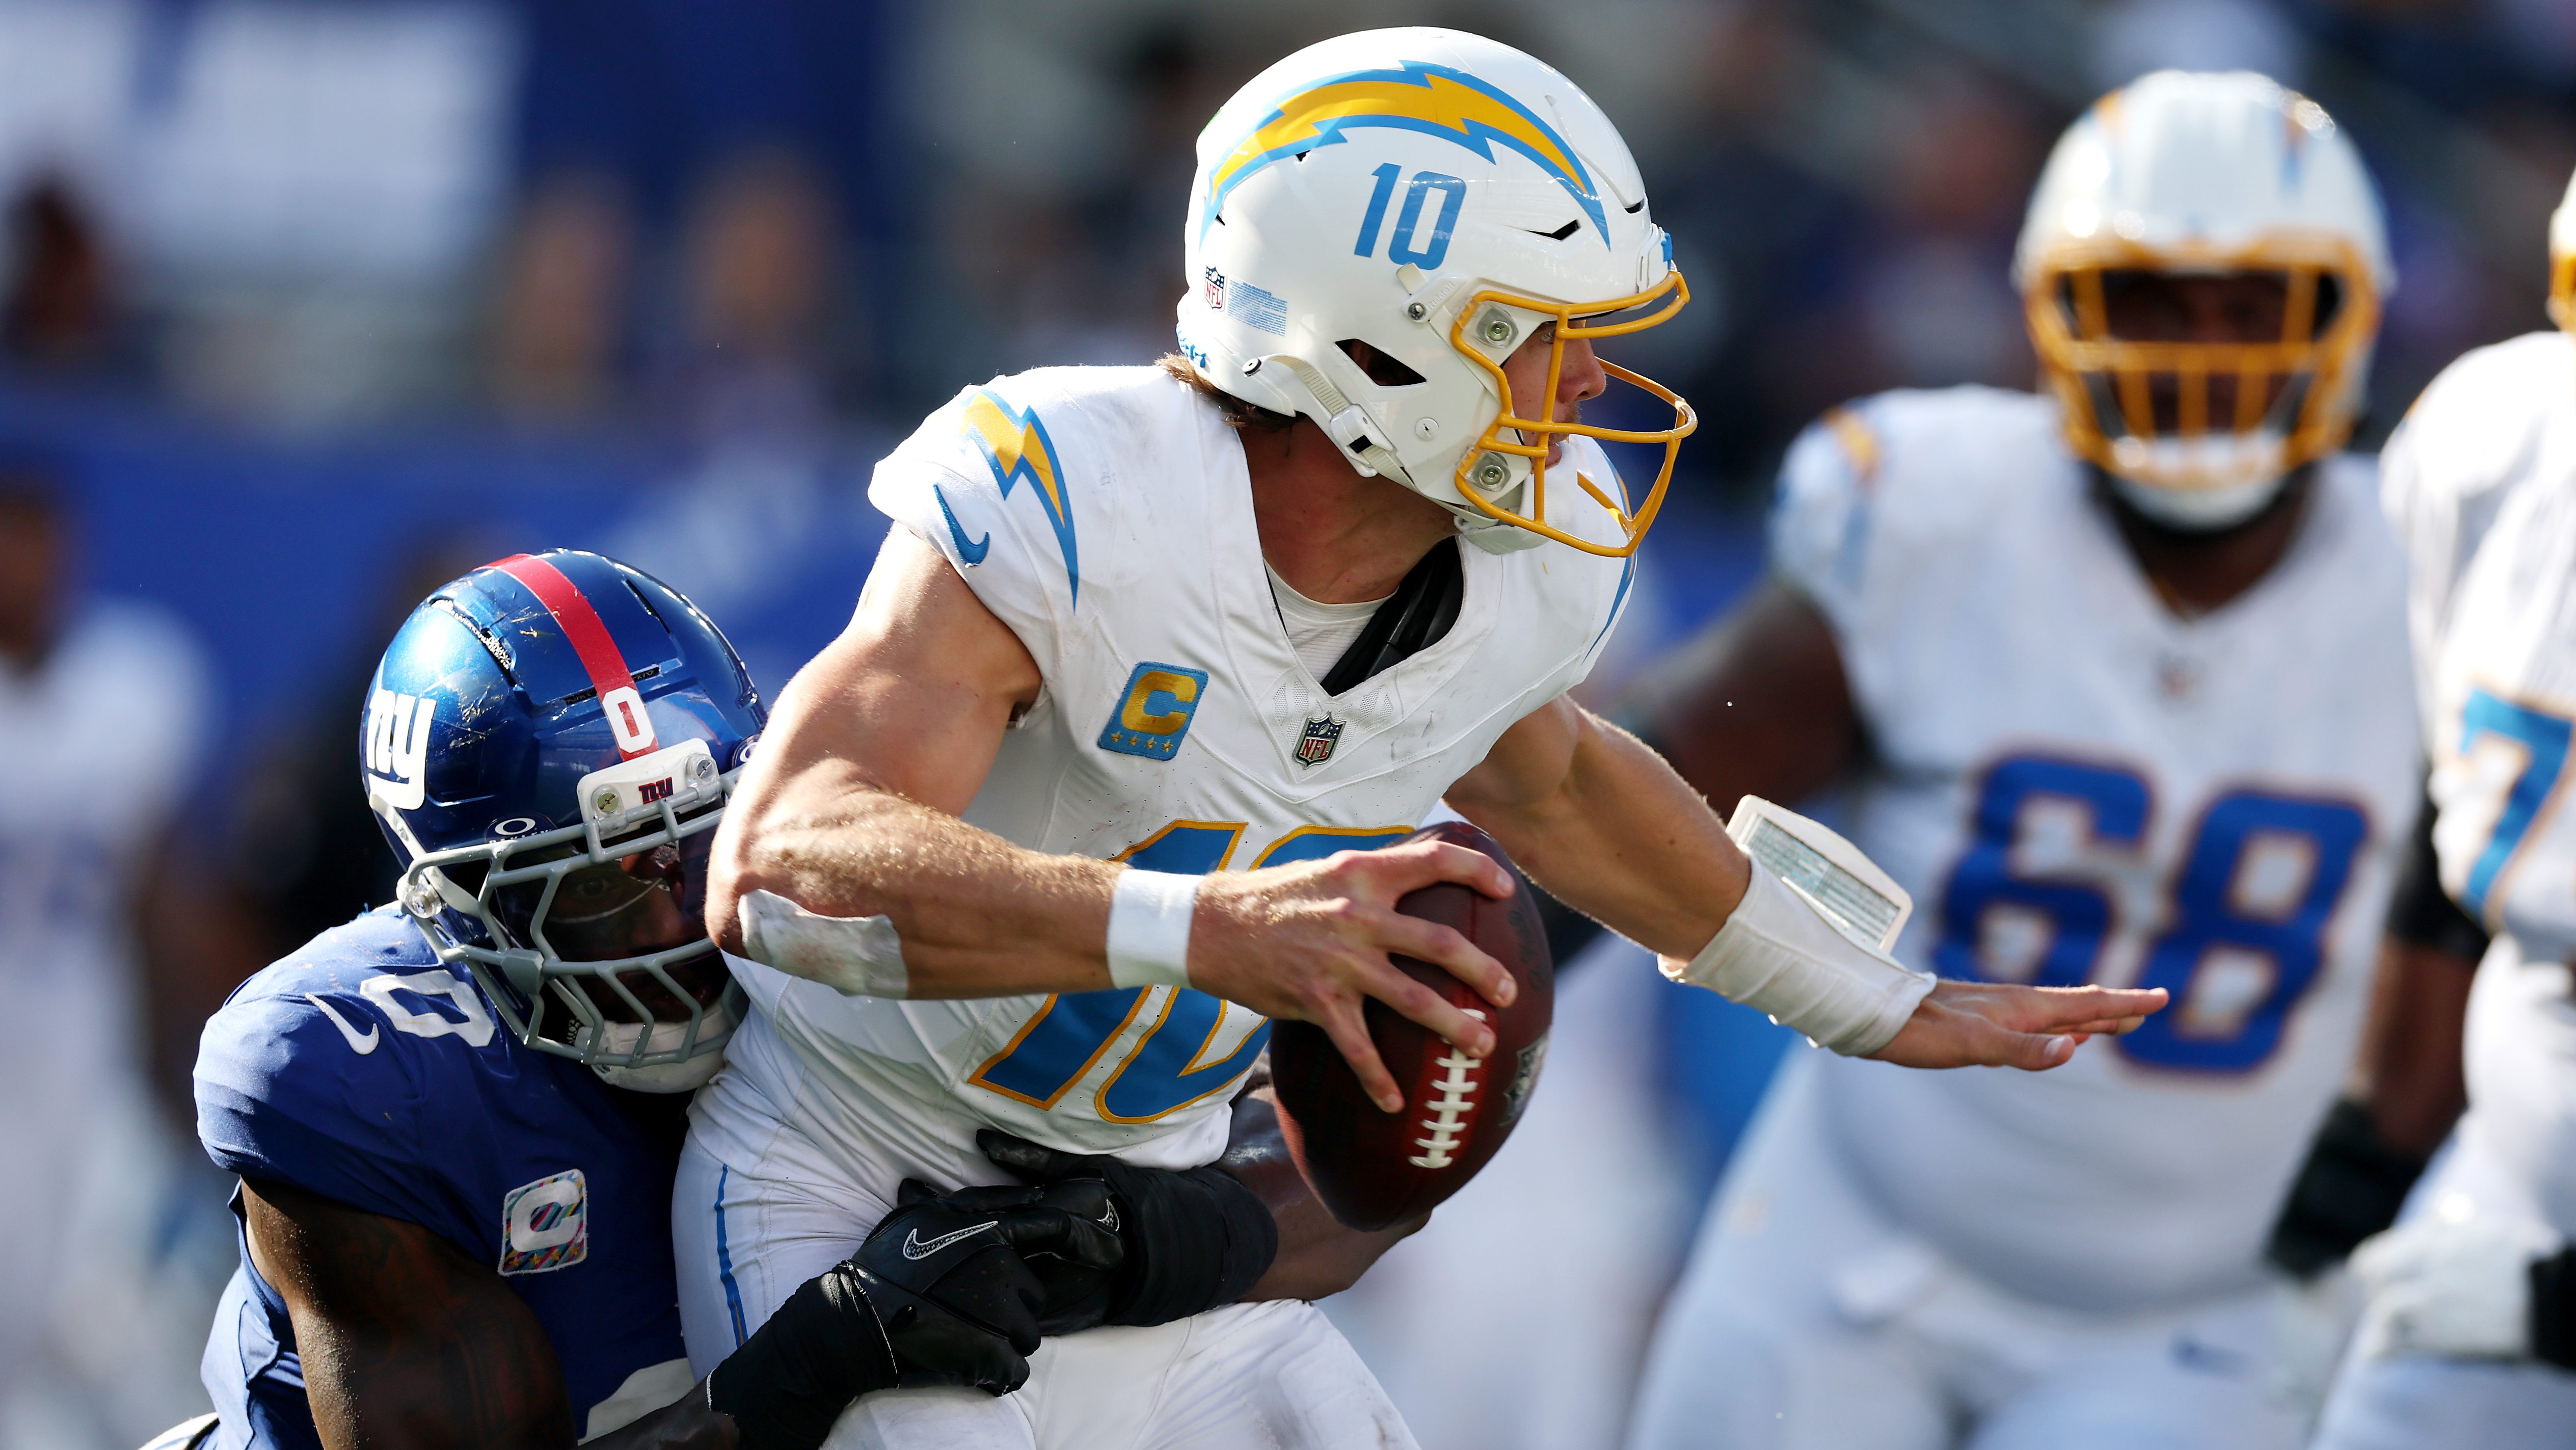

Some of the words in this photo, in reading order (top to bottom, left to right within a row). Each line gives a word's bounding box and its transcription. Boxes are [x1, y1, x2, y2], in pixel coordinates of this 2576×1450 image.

[1354, 162, 1467, 270] 10
[1205, 281, 1221, 306] NFL
[1242, 281, 1272, 296] WARNING
[602, 686, 655, 753] 0
[1121, 670, 1197, 736] C
[1299, 738, 1330, 761] NFL
[1928, 752, 2375, 1076] 68
[359, 969, 496, 1047] 0
[511, 1180, 581, 1253] C
